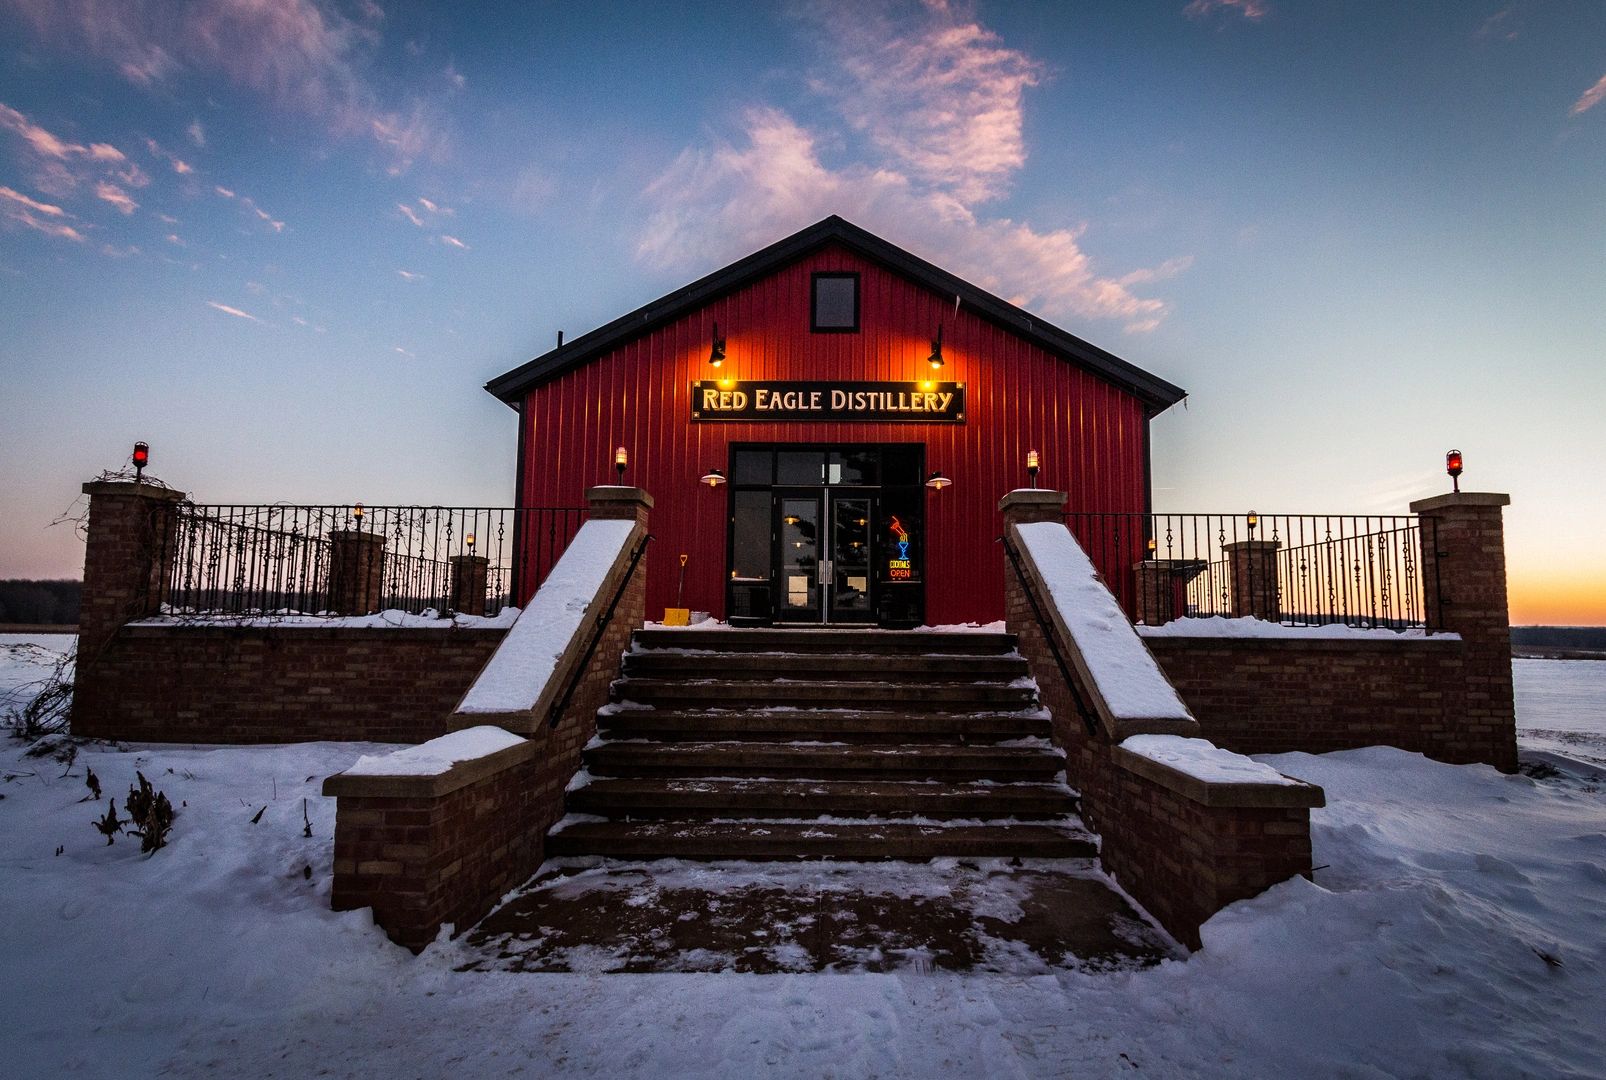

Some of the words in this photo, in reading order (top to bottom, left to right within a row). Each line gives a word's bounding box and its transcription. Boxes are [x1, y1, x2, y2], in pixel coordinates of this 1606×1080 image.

[702, 388, 748, 411] RED
[755, 389, 822, 411] EAGLE
[830, 389, 954, 412] DISTILLERY
[890, 569, 910, 578] OPEN
